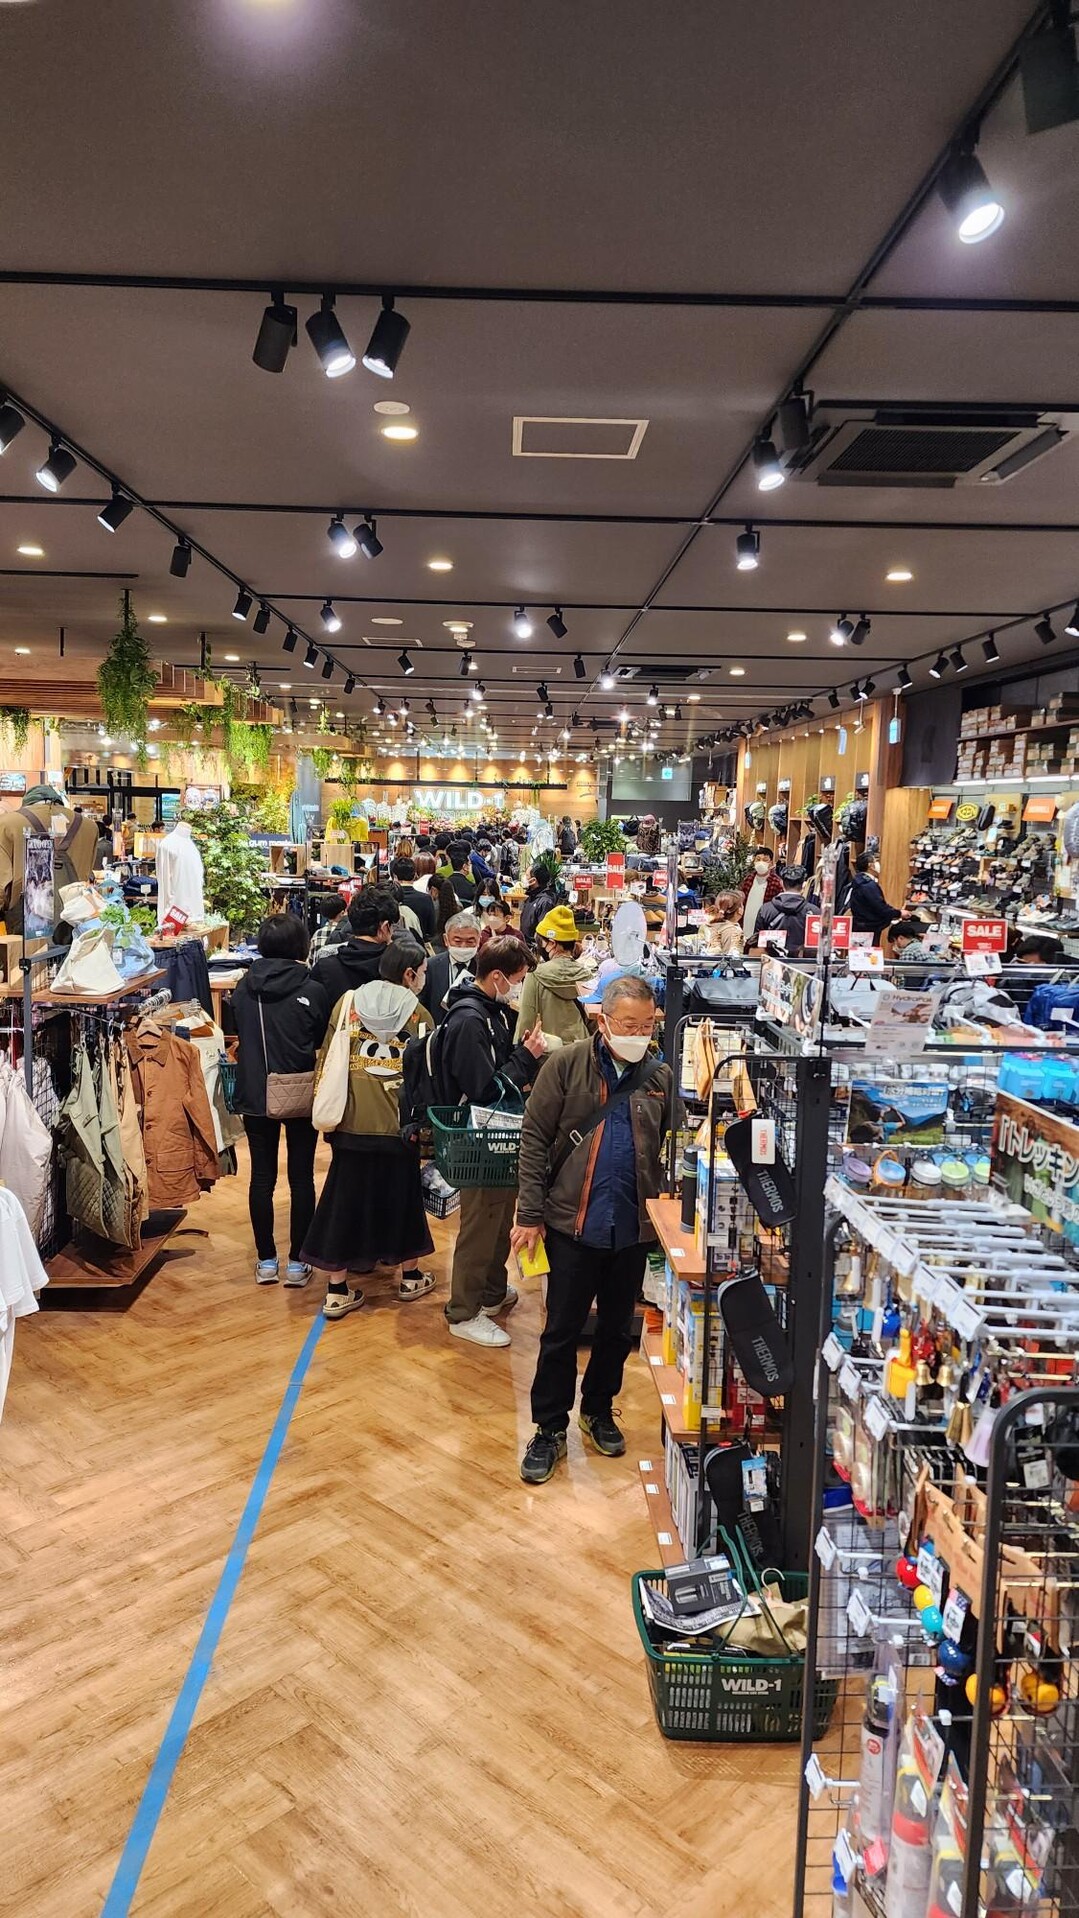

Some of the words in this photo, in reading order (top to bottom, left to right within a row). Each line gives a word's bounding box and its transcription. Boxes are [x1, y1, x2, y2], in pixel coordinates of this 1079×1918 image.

[414, 791, 504, 809] WILD-1
[169, 908, 187, 925] SALE
[967, 925, 1002, 937] SALE
[488, 1142, 520, 1151] WILD-
[758, 1130, 768, 1155] THERMOS
[757, 1169, 783, 1213] THERMOS
[752, 1336, 779, 1382] THERMOS
[721, 1679, 782, 1691] WILD-1
